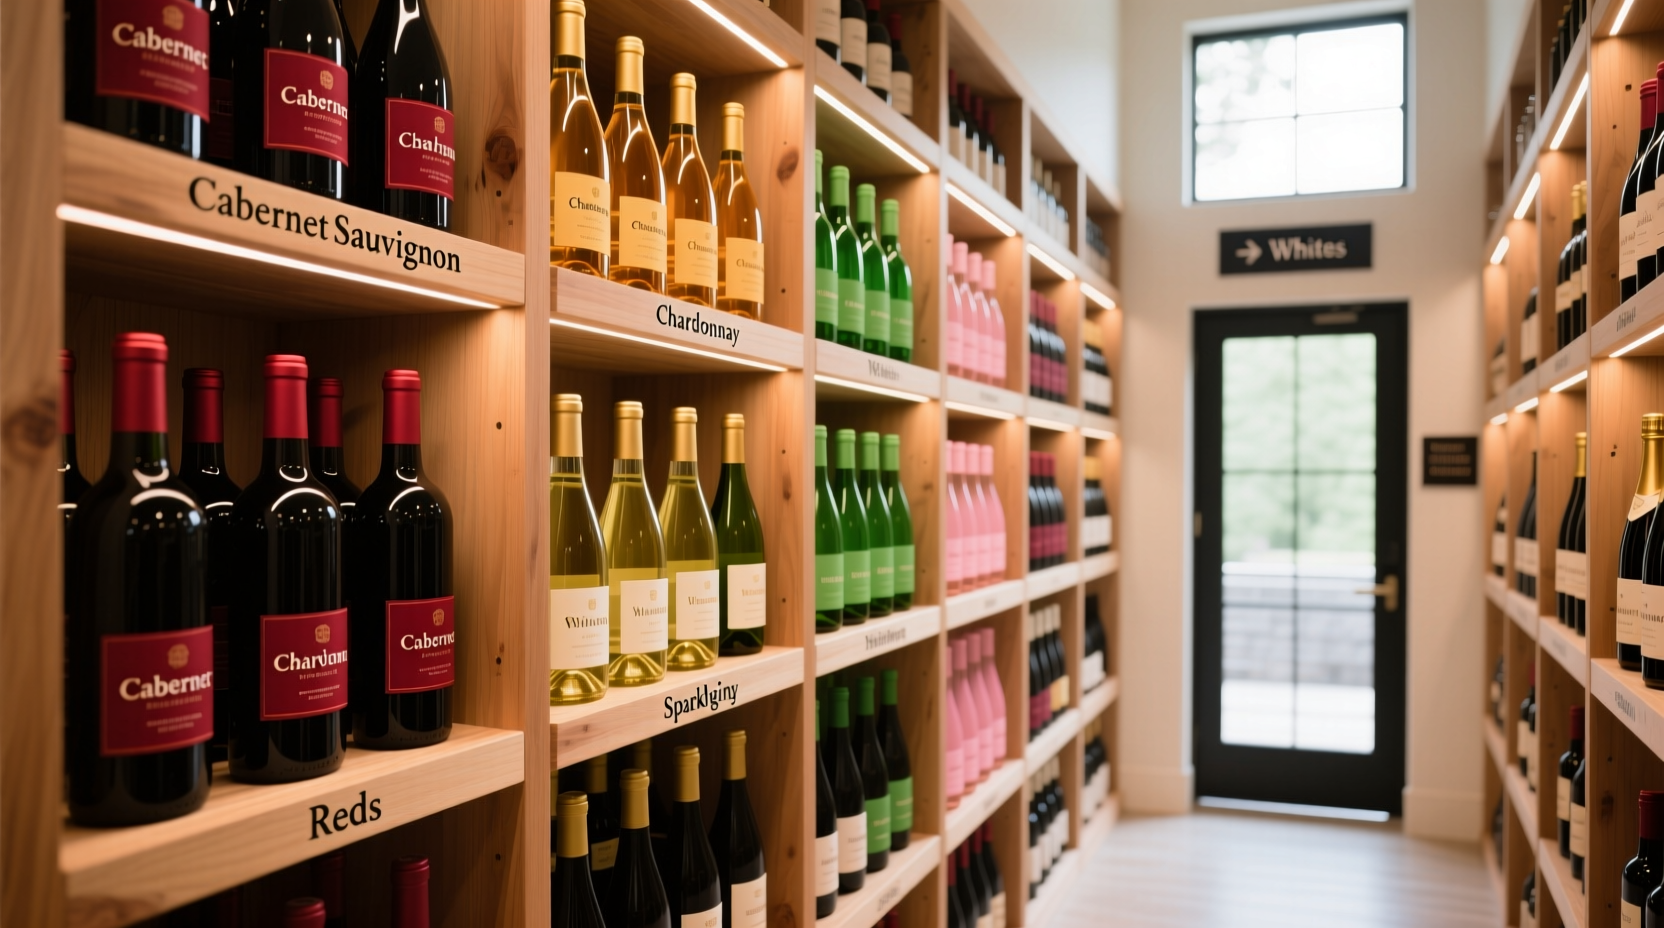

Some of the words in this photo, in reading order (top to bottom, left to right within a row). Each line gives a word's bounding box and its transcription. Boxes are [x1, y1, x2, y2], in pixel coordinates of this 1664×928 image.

[189, 177, 329, 240] Cabernet
[334, 214, 461, 273] Sauvignon
[1268, 236, 1348, 262] Whites
[656, 304, 740, 347] Chardonnay
[308, 790, 382, 840] Reds
